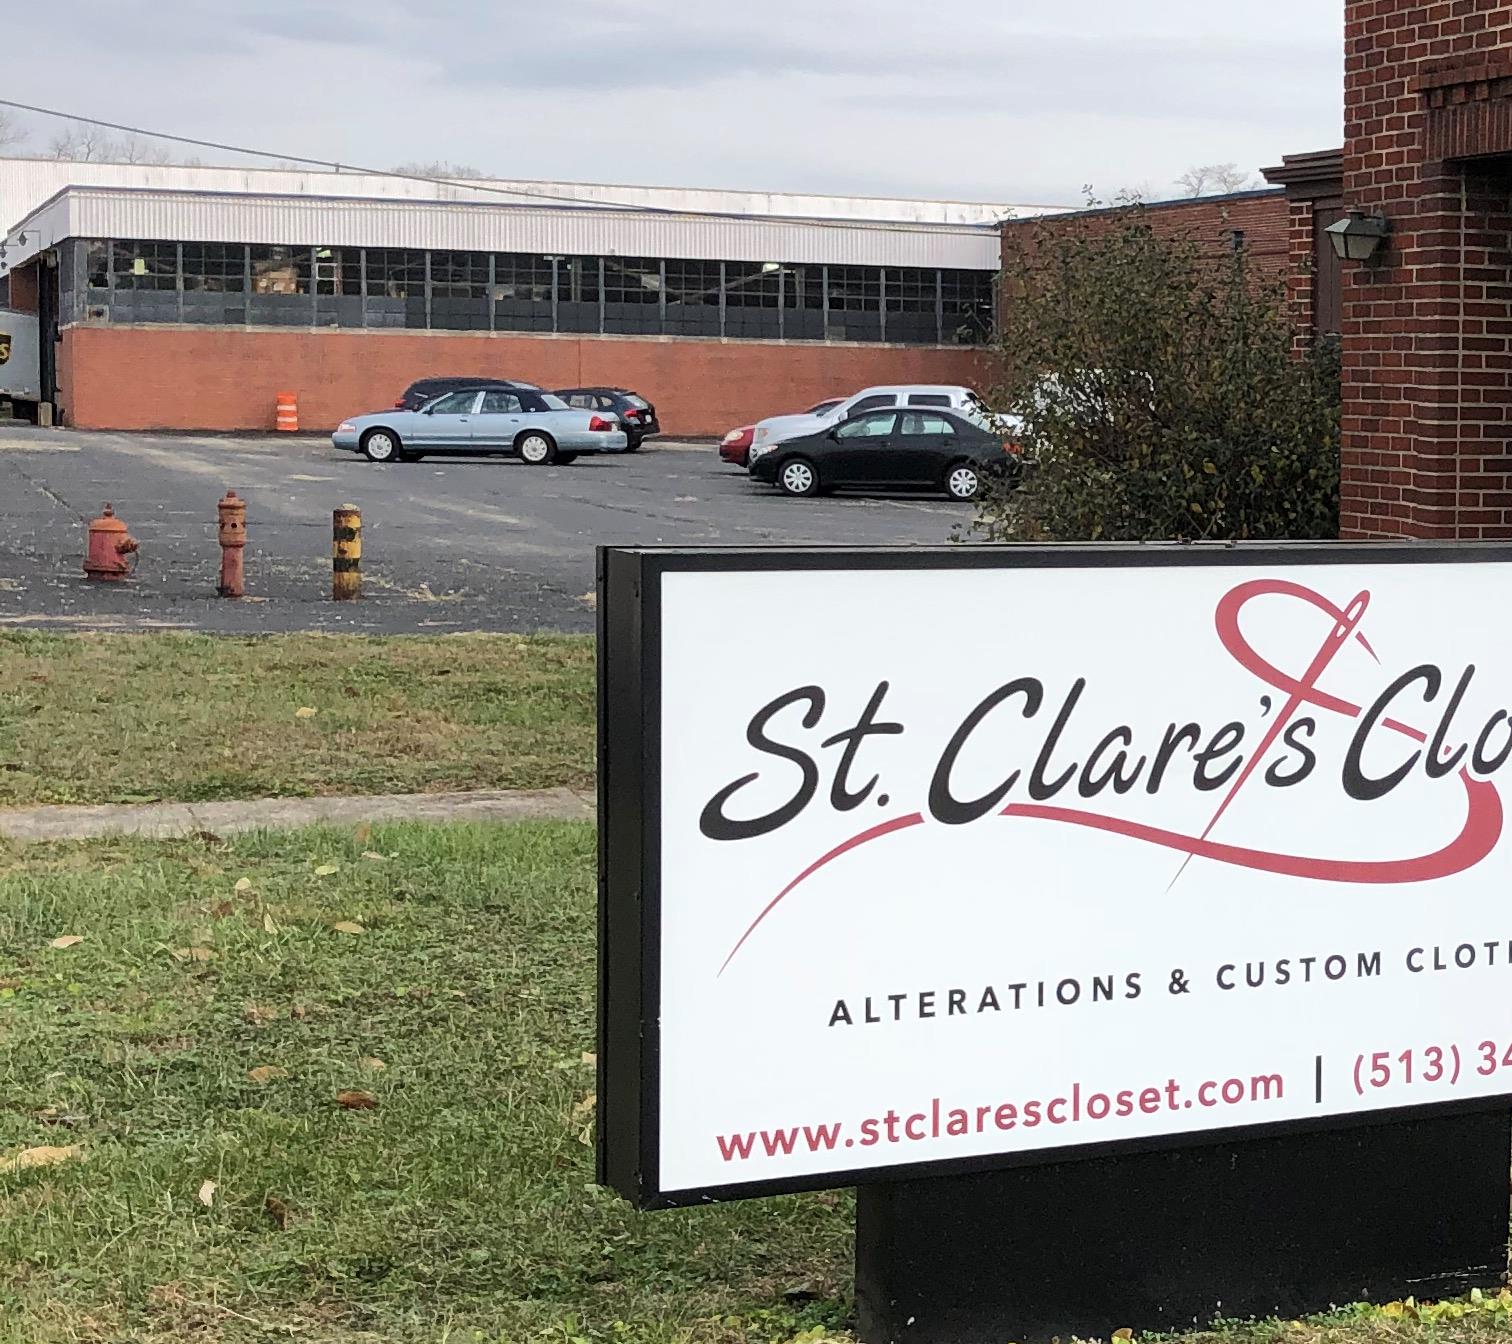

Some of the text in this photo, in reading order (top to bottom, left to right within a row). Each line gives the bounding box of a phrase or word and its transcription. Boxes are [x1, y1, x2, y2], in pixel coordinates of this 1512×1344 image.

[698, 680, 904, 842] St.
[927, 676, 1317, 826] Clare's
[827, 972, 1142, 1027] ALTERATIONS
[1168, 968, 1191, 995] &
[1215, 951, 1382, 991] CUSTOM
[715, 1073, 1284, 1162] www.stclarescloset.com
[1352, 1045, 1462, 1096] (513)
